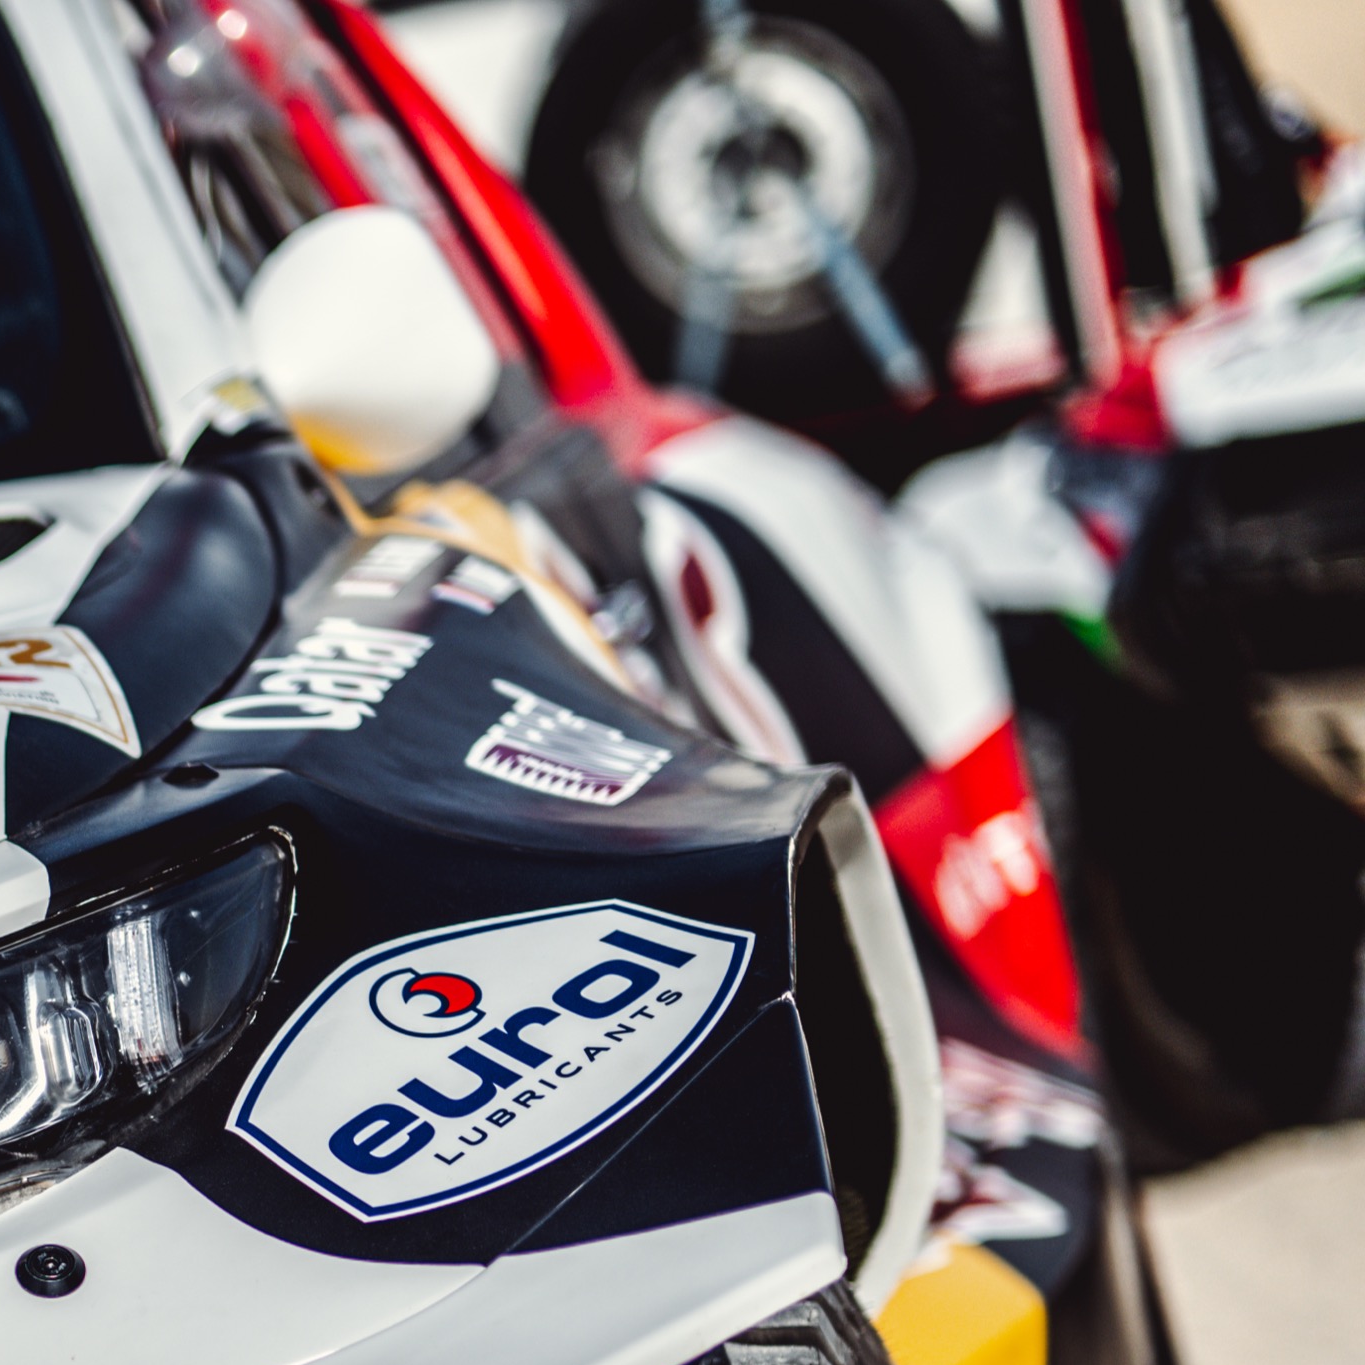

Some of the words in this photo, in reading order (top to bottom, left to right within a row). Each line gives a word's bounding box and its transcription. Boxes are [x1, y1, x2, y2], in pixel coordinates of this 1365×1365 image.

[191, 617, 434, 730] Qatar
[328, 929, 698, 1174] eurol
[434, 988, 684, 1166] LUBRICANTS
